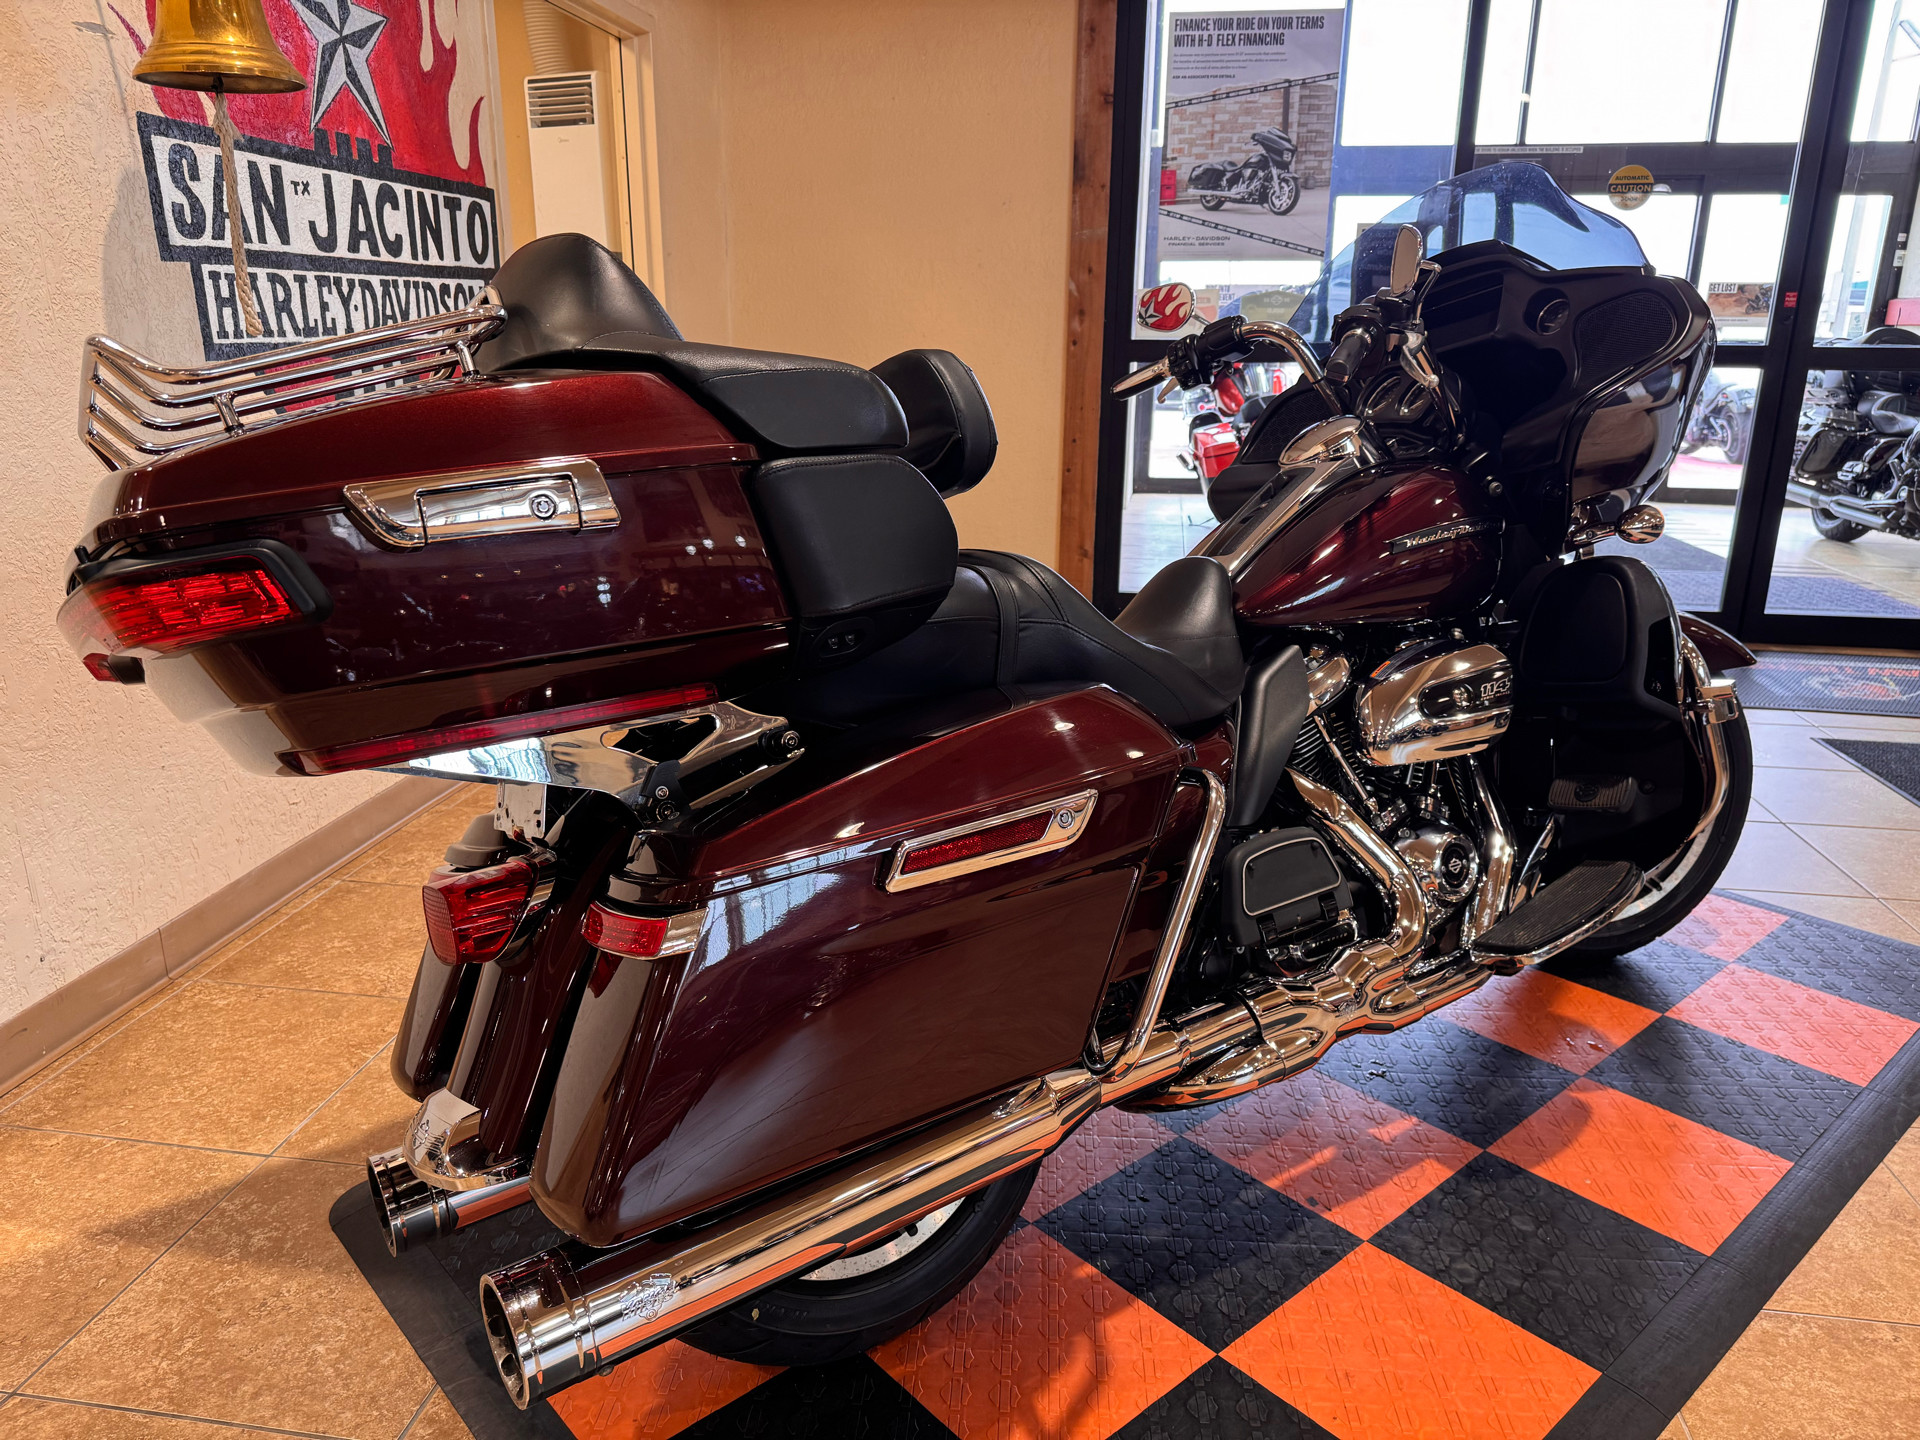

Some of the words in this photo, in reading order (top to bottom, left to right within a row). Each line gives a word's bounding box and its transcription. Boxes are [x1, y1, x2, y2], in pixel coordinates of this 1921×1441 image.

[1174, 17, 1211, 32] FINANCE
[1212, 16, 1235, 31] YOUR
[1236, 16, 1256, 31] RIDE
[1257, 16, 1270, 30] ON
[1271, 15, 1294, 30] YOUR
[1295, 14, 1325, 30] TERMS
[1173, 33, 1196, 48] WITH
[1215, 32, 1237, 47] FLEX
[1238, 31, 1286, 46] FINANCING
[290, 180, 311, 196] TX
[1610, 185, 1652, 193] CAUTION
[168, 143, 291, 246] SAN
[308, 173, 491, 266] JACINTO
[1709, 285, 1721, 293] GET
[1721, 284, 1737, 293] LOST
[1480, 677, 1511, 697] 114
